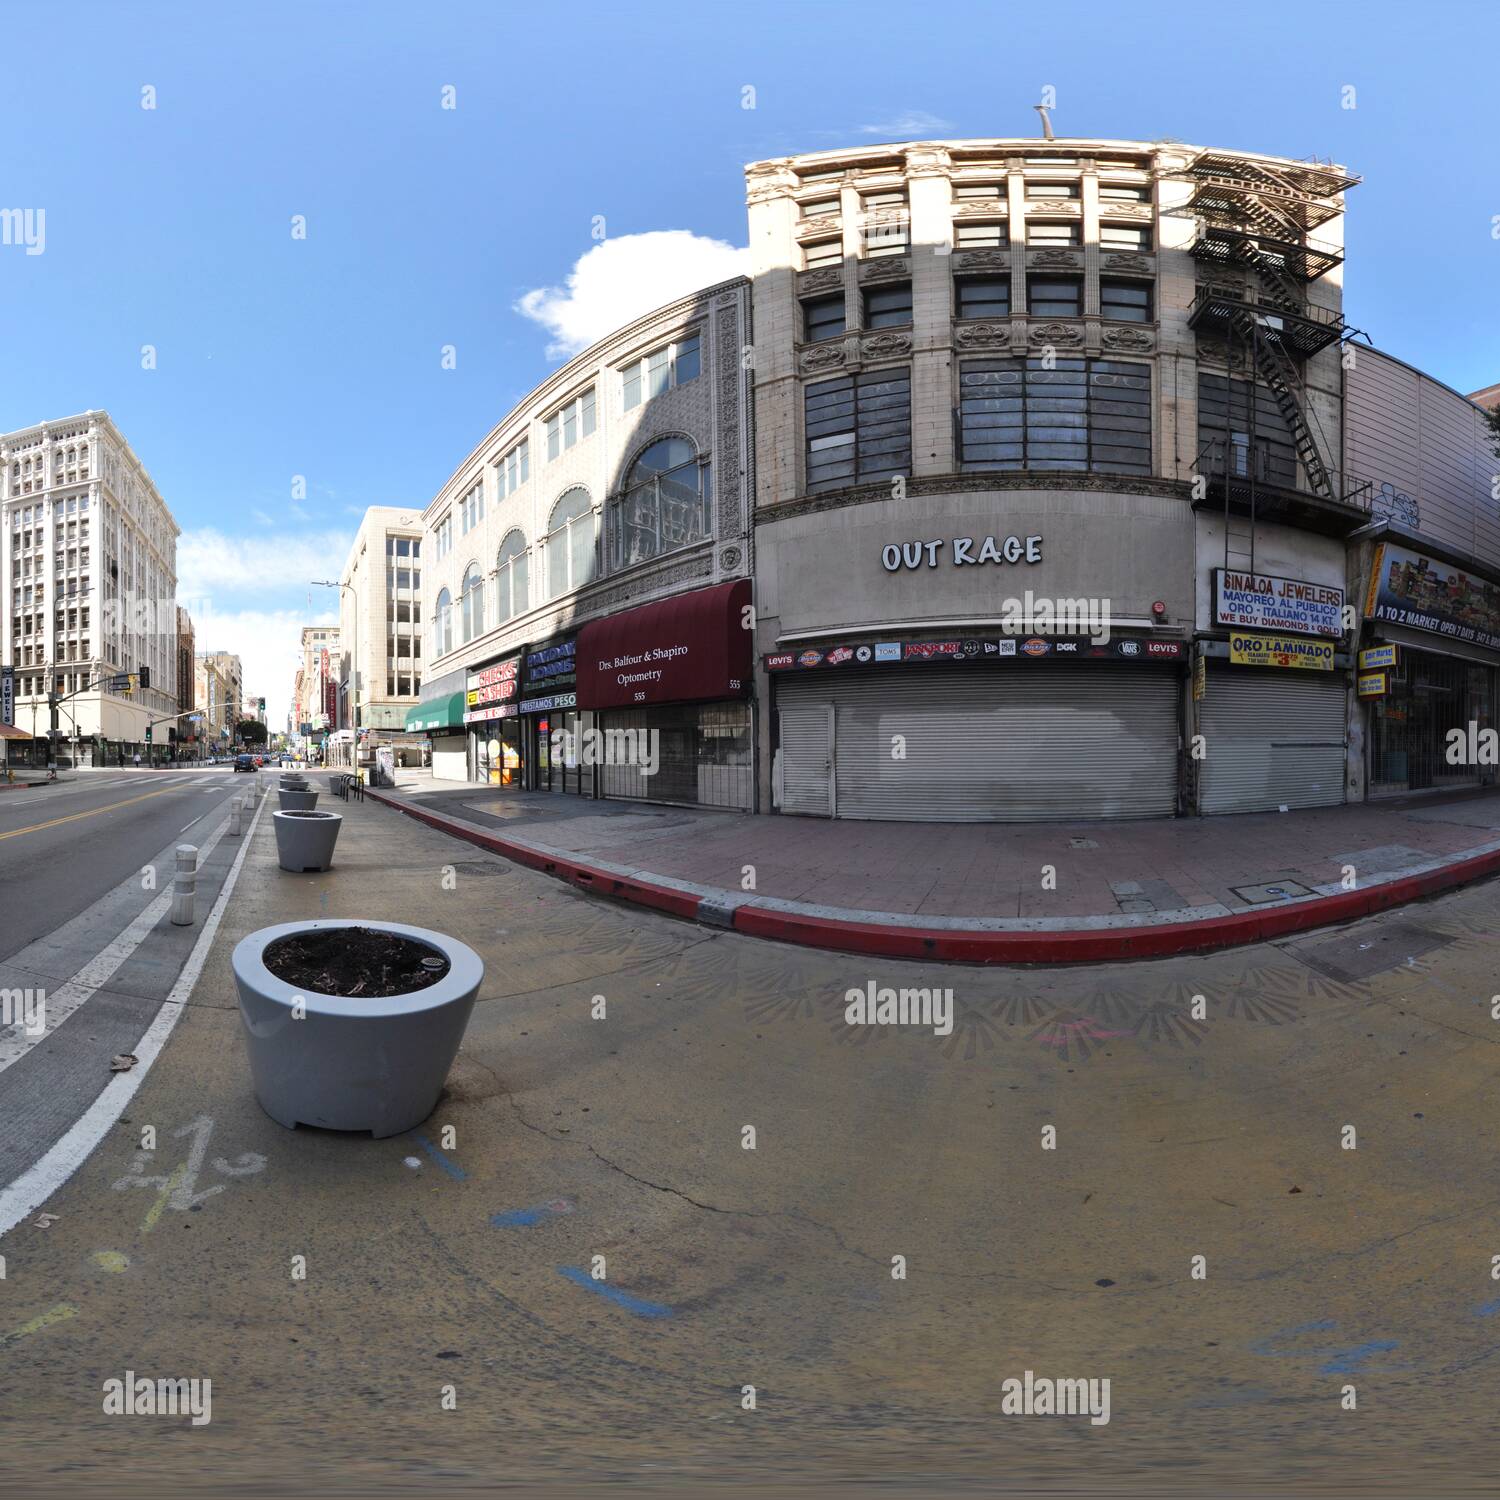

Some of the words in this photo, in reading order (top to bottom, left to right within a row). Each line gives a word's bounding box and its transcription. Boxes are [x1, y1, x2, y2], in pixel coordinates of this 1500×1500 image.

[882, 539, 943, 571] OUT
[953, 535, 1043, 565] RAGE
[1224, 573, 1273, 596] SINALOA
[1278, 582, 1340, 607] JEWELERS
[1223, 591, 1276, 606] MAYOREO
[1280, 599, 1293, 608] AL
[1296, 601, 1337, 616] PUBLICO
[1229, 602, 1253, 614] ORO
[1263, 607, 1307, 621] ITALIANO
[1310, 614, 1319, 623] 14
[1220, 612, 1235, 622] WE
[1240, 615, 1258, 625] BUY
[1262, 617, 1308, 631] DIAMONDS
[1317, 625, 1339, 636] GOLD
[1377, 605, 1383, 617] A
[1386, 606, 1398, 620] TO
[1398, 609, 1405, 622] Z
[1406, 612, 1440, 631] MARKET
[1440, 621, 1456, 635] OPEN
[1456, 625, 1461, 636] 7
[1460, 627, 1475, 640] DAYS
[599, 661, 613, 671] Drs.
[614, 654, 642, 668] Balfour
[644, 651, 652, 662] &
[652, 645, 688, 660] Shapiro
[1057, 642, 1077, 652] DGK
[1121, 642, 1138, 654] VANS
[1233, 637, 1262, 652] ORO
[1266, 641, 1331, 658] LAMINADO
[479, 661, 517, 687] CHECKS
[617, 669, 662, 686] Optometry
[729, 679, 740, 689] 555
[478, 680, 517, 704] CASHED
[634, 692, 646, 701] 555
[521, 698, 552, 711] PRESTAMOS
